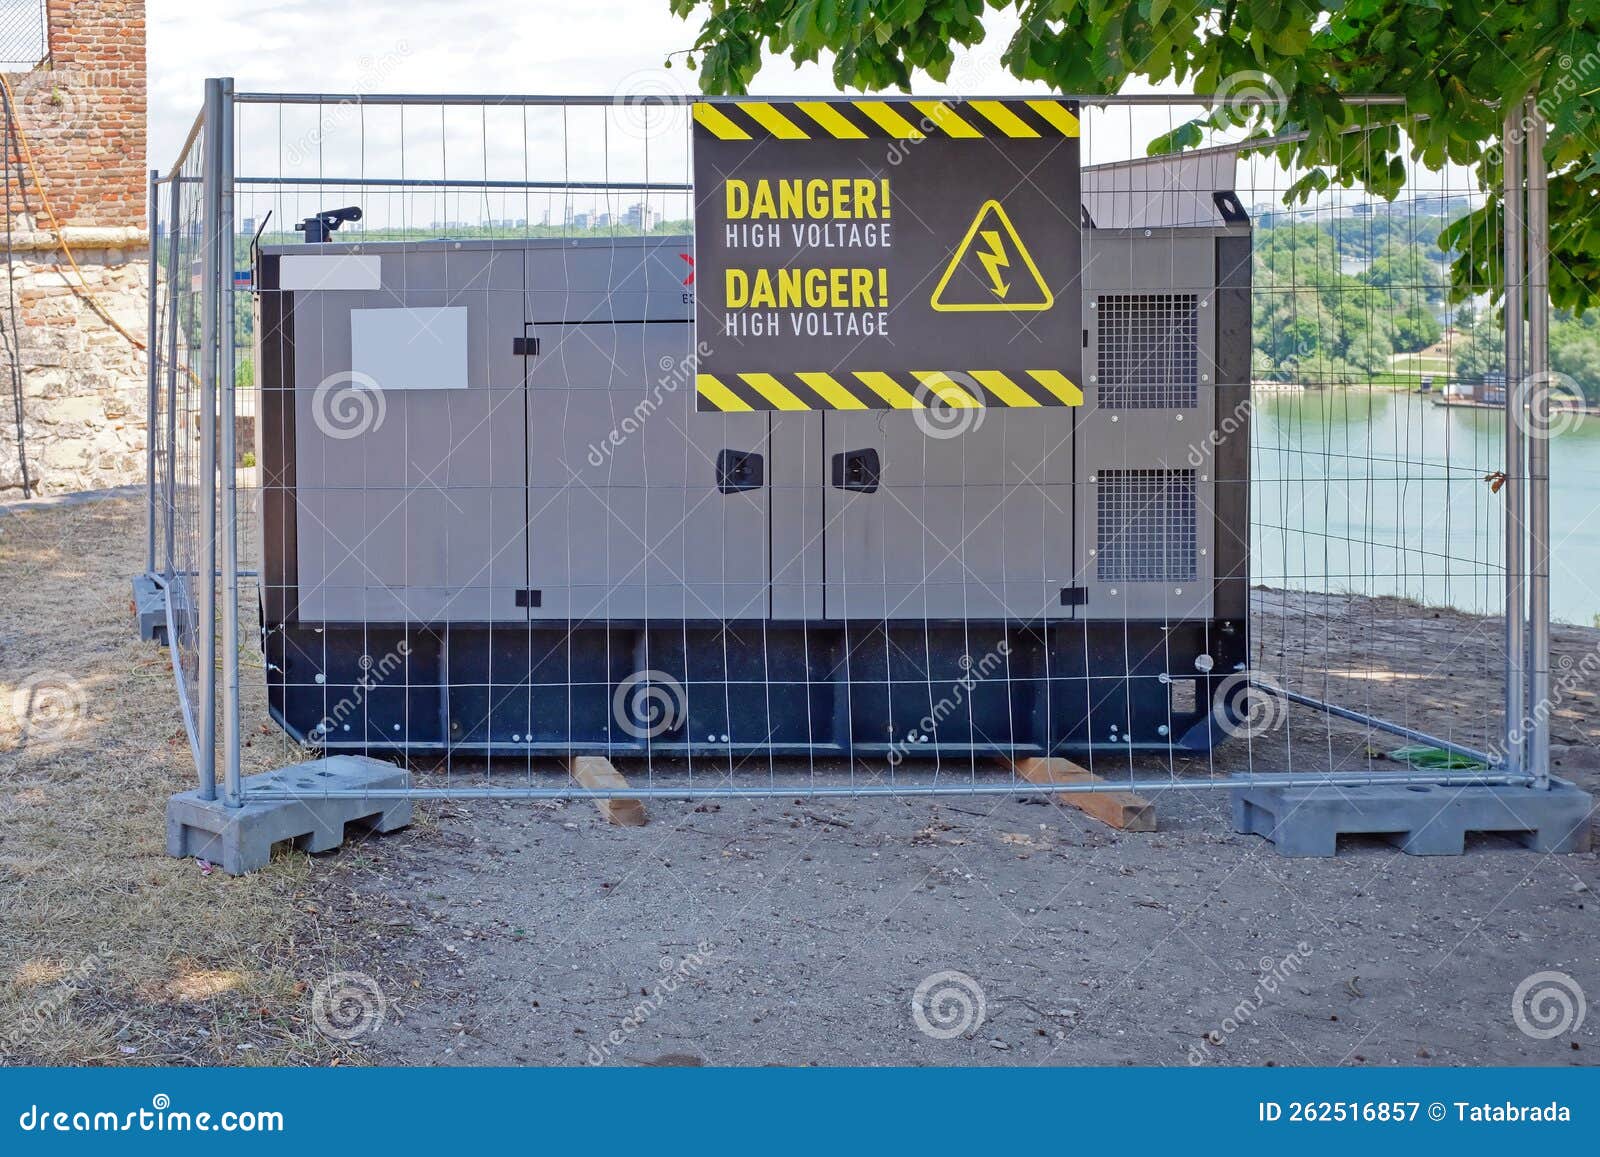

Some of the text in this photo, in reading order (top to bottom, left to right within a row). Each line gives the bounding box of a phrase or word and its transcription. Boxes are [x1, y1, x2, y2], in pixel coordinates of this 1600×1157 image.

[725, 179, 892, 220] DANGER!
[725, 223, 891, 248] HIGH VOLTAGE
[725, 268, 889, 308] DANGER!
[725, 312, 889, 336] HIGH VOLTAGE
